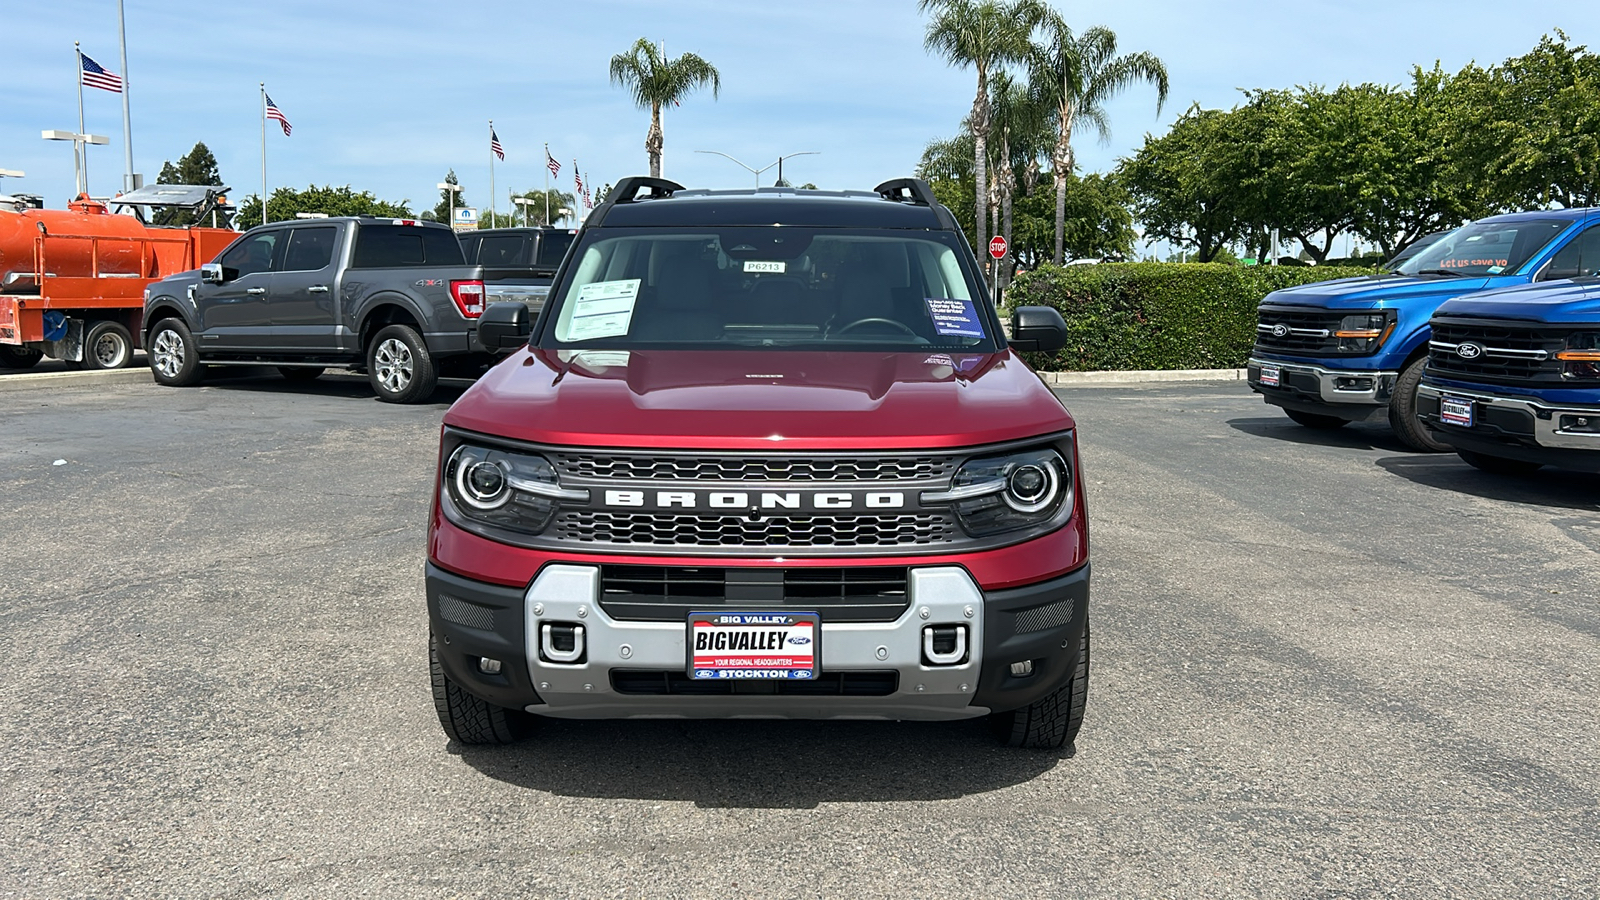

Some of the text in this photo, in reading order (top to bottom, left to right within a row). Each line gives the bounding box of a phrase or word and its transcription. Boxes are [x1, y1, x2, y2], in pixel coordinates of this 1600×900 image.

[991, 243, 1006, 252] STOP
[747, 263, 780, 271] P6213
[1440, 258, 1456, 268] Let
[1457, 259, 1469, 268] us
[605, 490, 904, 508] BRONCO
[695, 631, 789, 650] BIGVALLEY
[714, 658, 793, 666] YOUR REGIONAL HEADQUARTERS
[719, 670, 789, 678] STOCKTON
